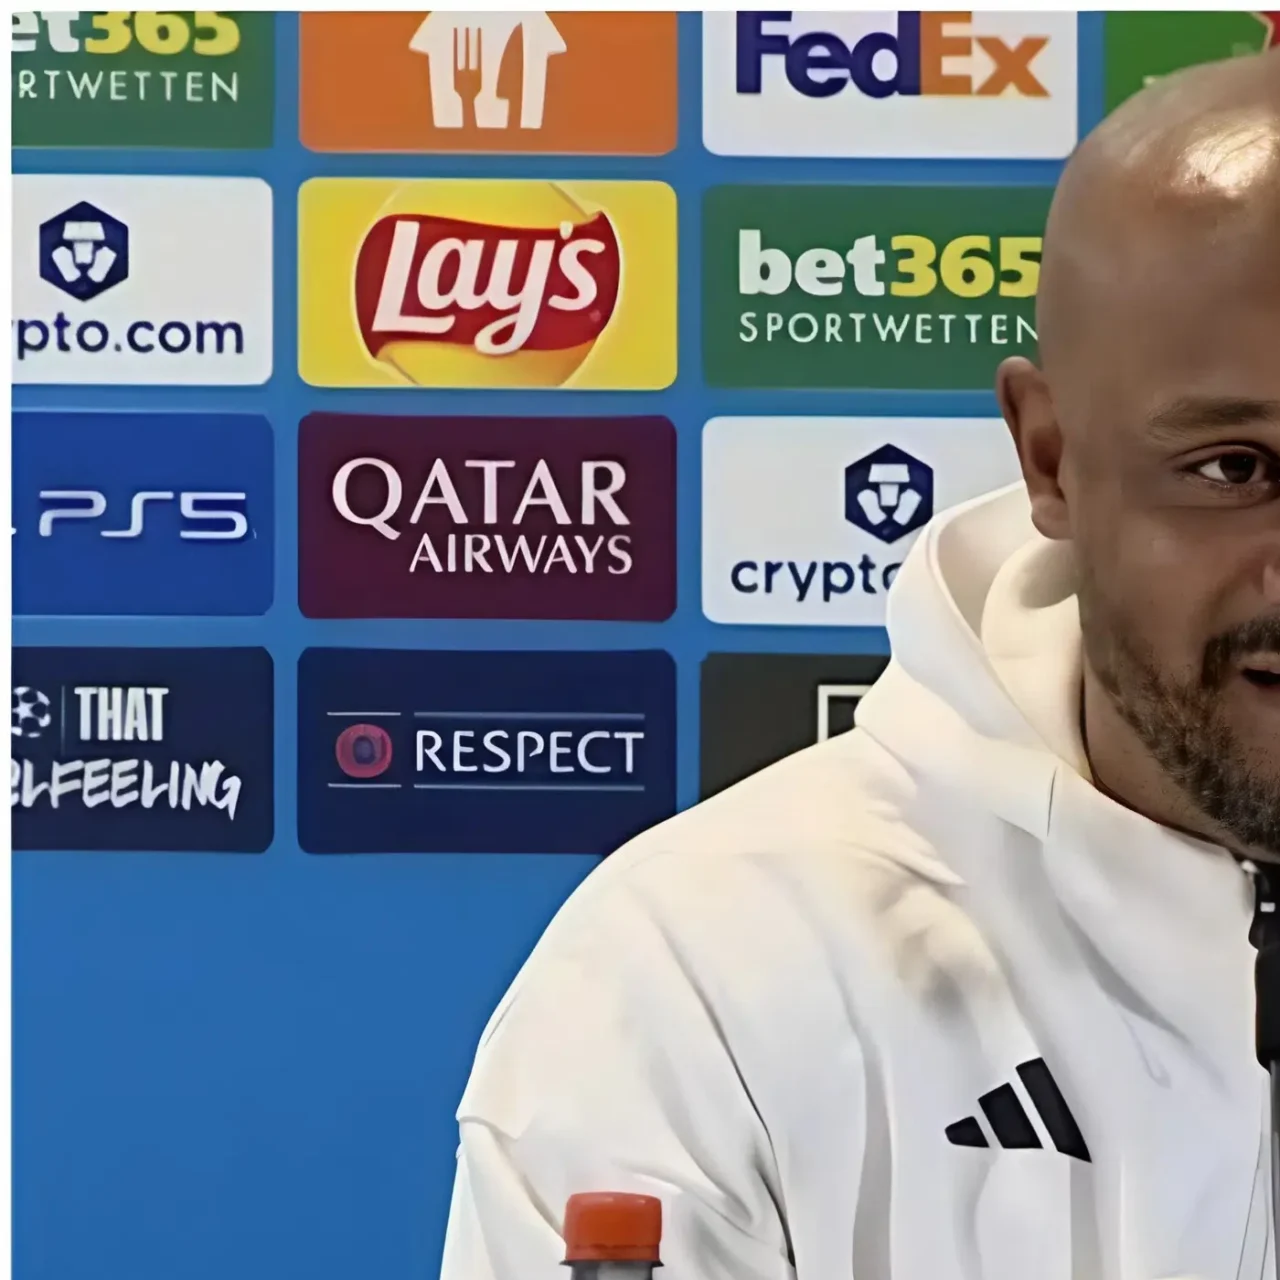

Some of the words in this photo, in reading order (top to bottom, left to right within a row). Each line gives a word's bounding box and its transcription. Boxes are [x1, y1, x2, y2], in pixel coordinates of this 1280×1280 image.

[735, 11, 1051, 98] FedEx
[371, 219, 607, 356] Lay's
[738, 228, 1043, 298] bet365
[12, 312, 243, 360] pto.com
[39, 490, 249, 540] PS5
[332, 457, 628, 540] QATAR
[409, 533, 633, 574] AIRWAYS
[74, 686, 170, 741] THAT
[415, 730, 645, 774] RESPECT
